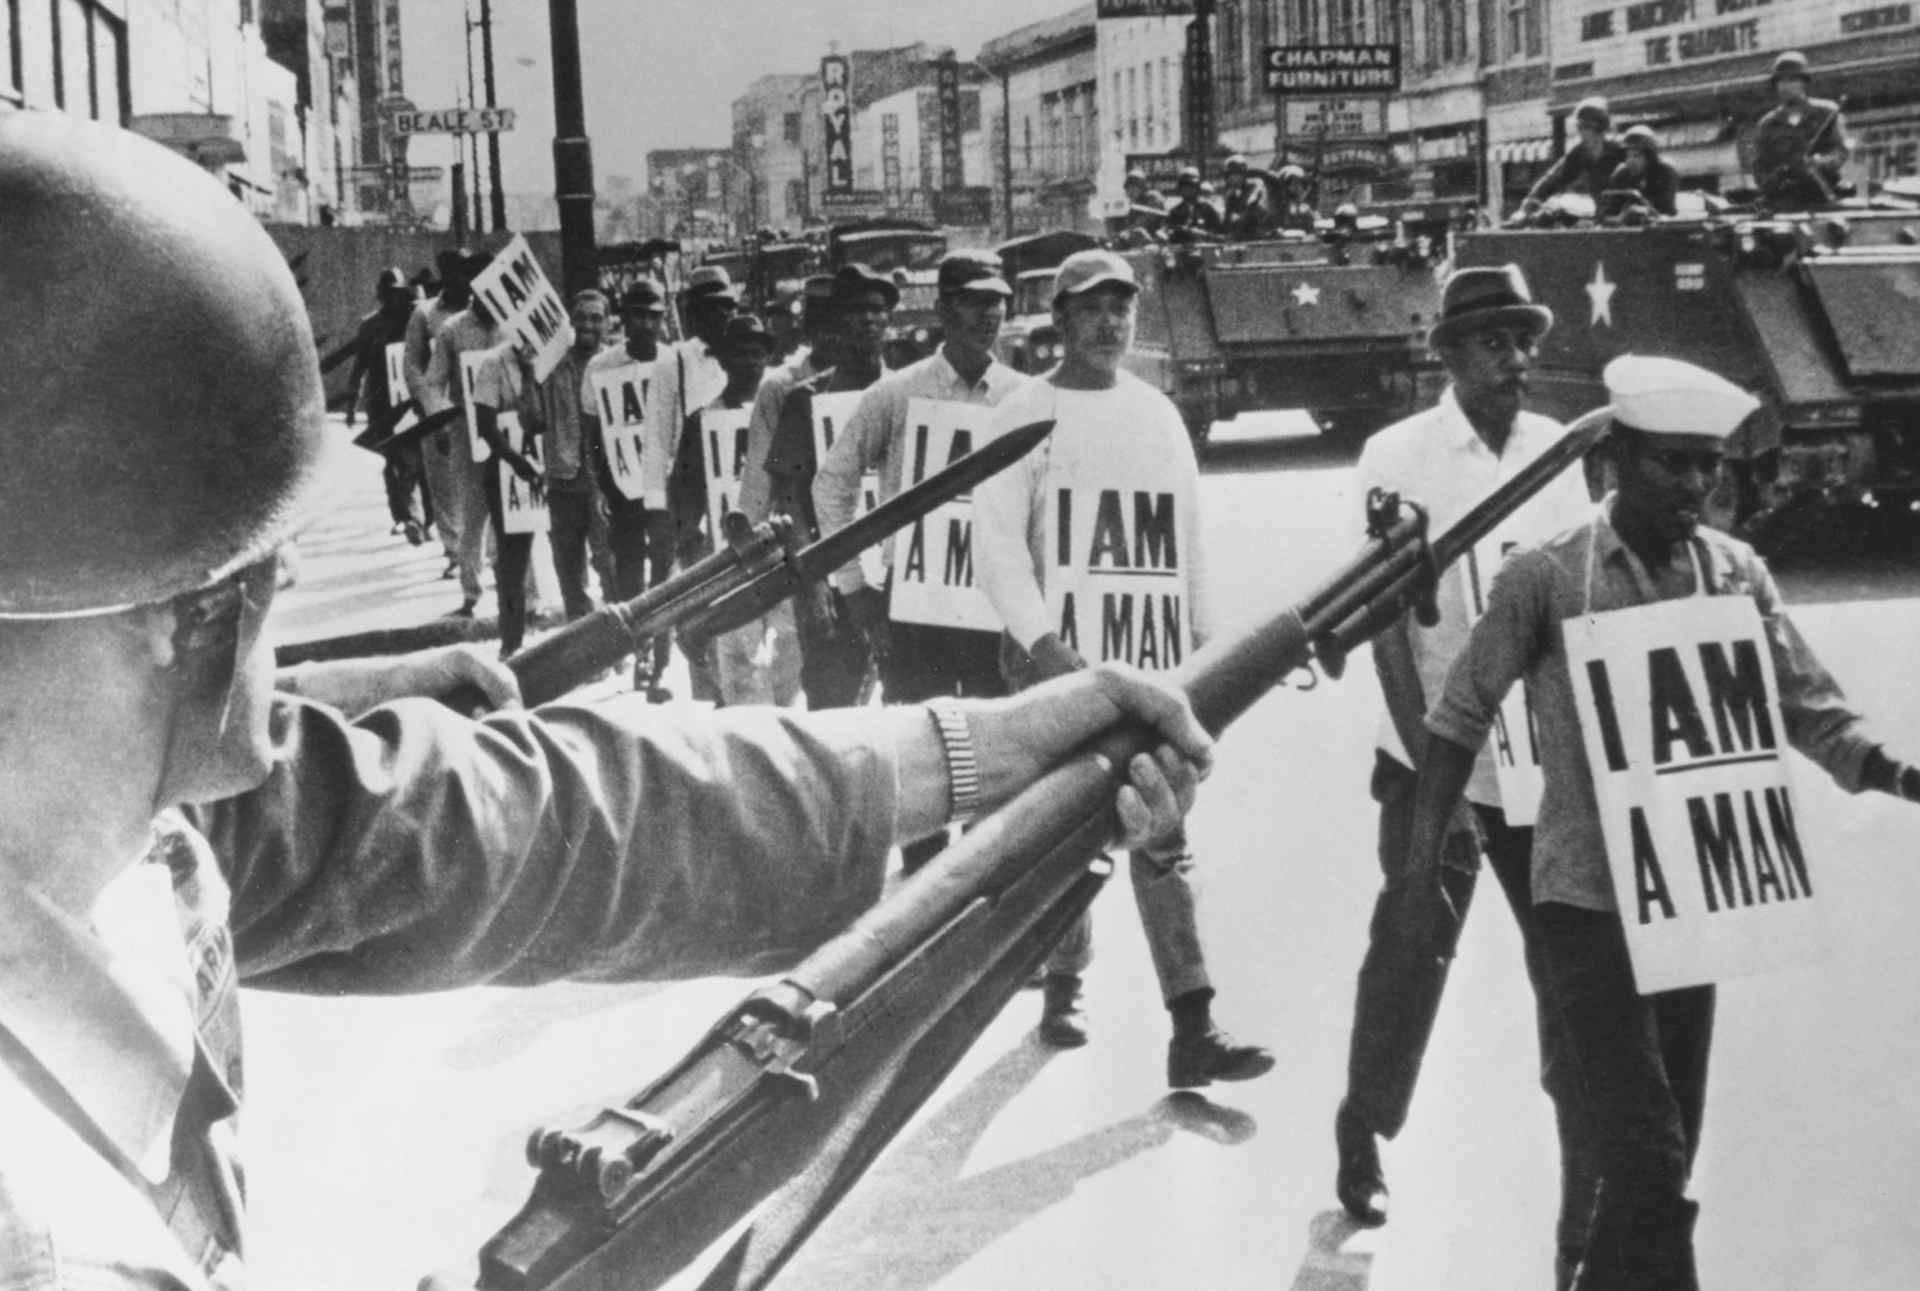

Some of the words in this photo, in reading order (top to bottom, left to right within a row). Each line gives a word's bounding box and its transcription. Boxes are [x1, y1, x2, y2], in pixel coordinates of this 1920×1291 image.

[1268, 69, 1394, 87] FURNITURE
[1270, 50, 1391, 67] CHAPMAN
[398, 112, 471, 132] BEALE
[825, 62, 848, 186] ROYAL
[484, 288, 508, 321] I
[499, 251, 539, 310] AM
[528, 294, 566, 346] MAN
[601, 386, 613, 426] I
[615, 437, 632, 477] A
[710, 430, 722, 478] I
[912, 425, 928, 486] I
[904, 514, 925, 584] A
[1057, 487, 1072, 567] I
[1087, 489, 1178, 570] AM
[1060, 591, 1078, 653] A
[1101, 592, 1182, 671] MAN
[1585, 658, 1629, 772] I
[1648, 639, 1777, 766] AM
[1629, 806, 1677, 925] A
[1687, 785, 1813, 913] MAN
